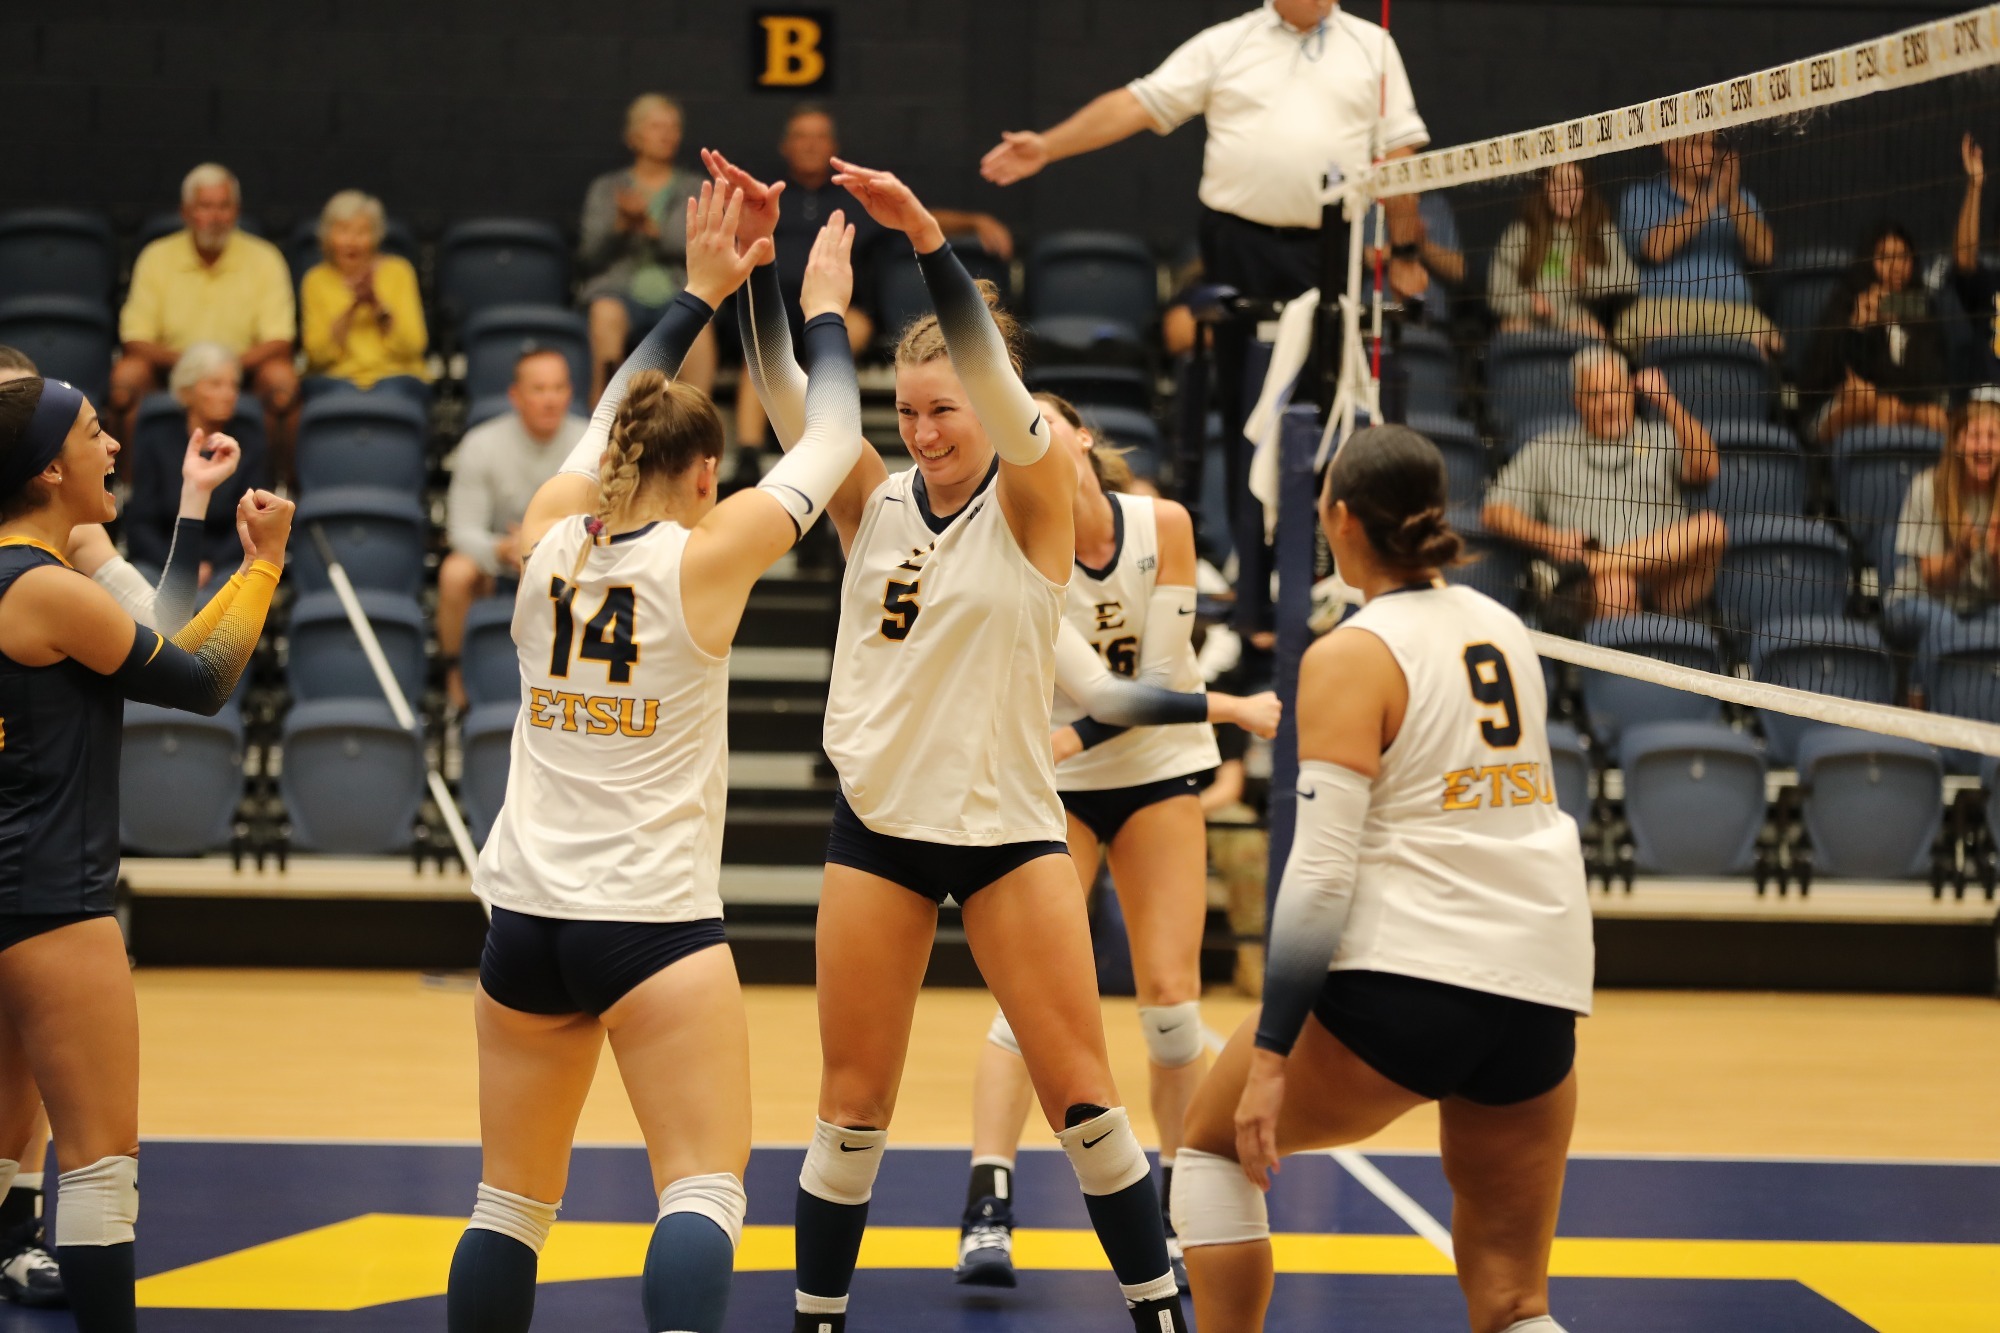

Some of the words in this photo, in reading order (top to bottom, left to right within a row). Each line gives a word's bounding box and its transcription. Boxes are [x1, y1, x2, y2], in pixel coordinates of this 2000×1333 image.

[758, 15, 825, 86] B
[548, 573, 640, 686] 14
[879, 578, 921, 642] 5
[1095, 602, 1125, 631] E
[530, 687, 660, 738] ETSU
[1461, 640, 1523, 749] 9
[1441, 763, 1554, 811] ETSU
